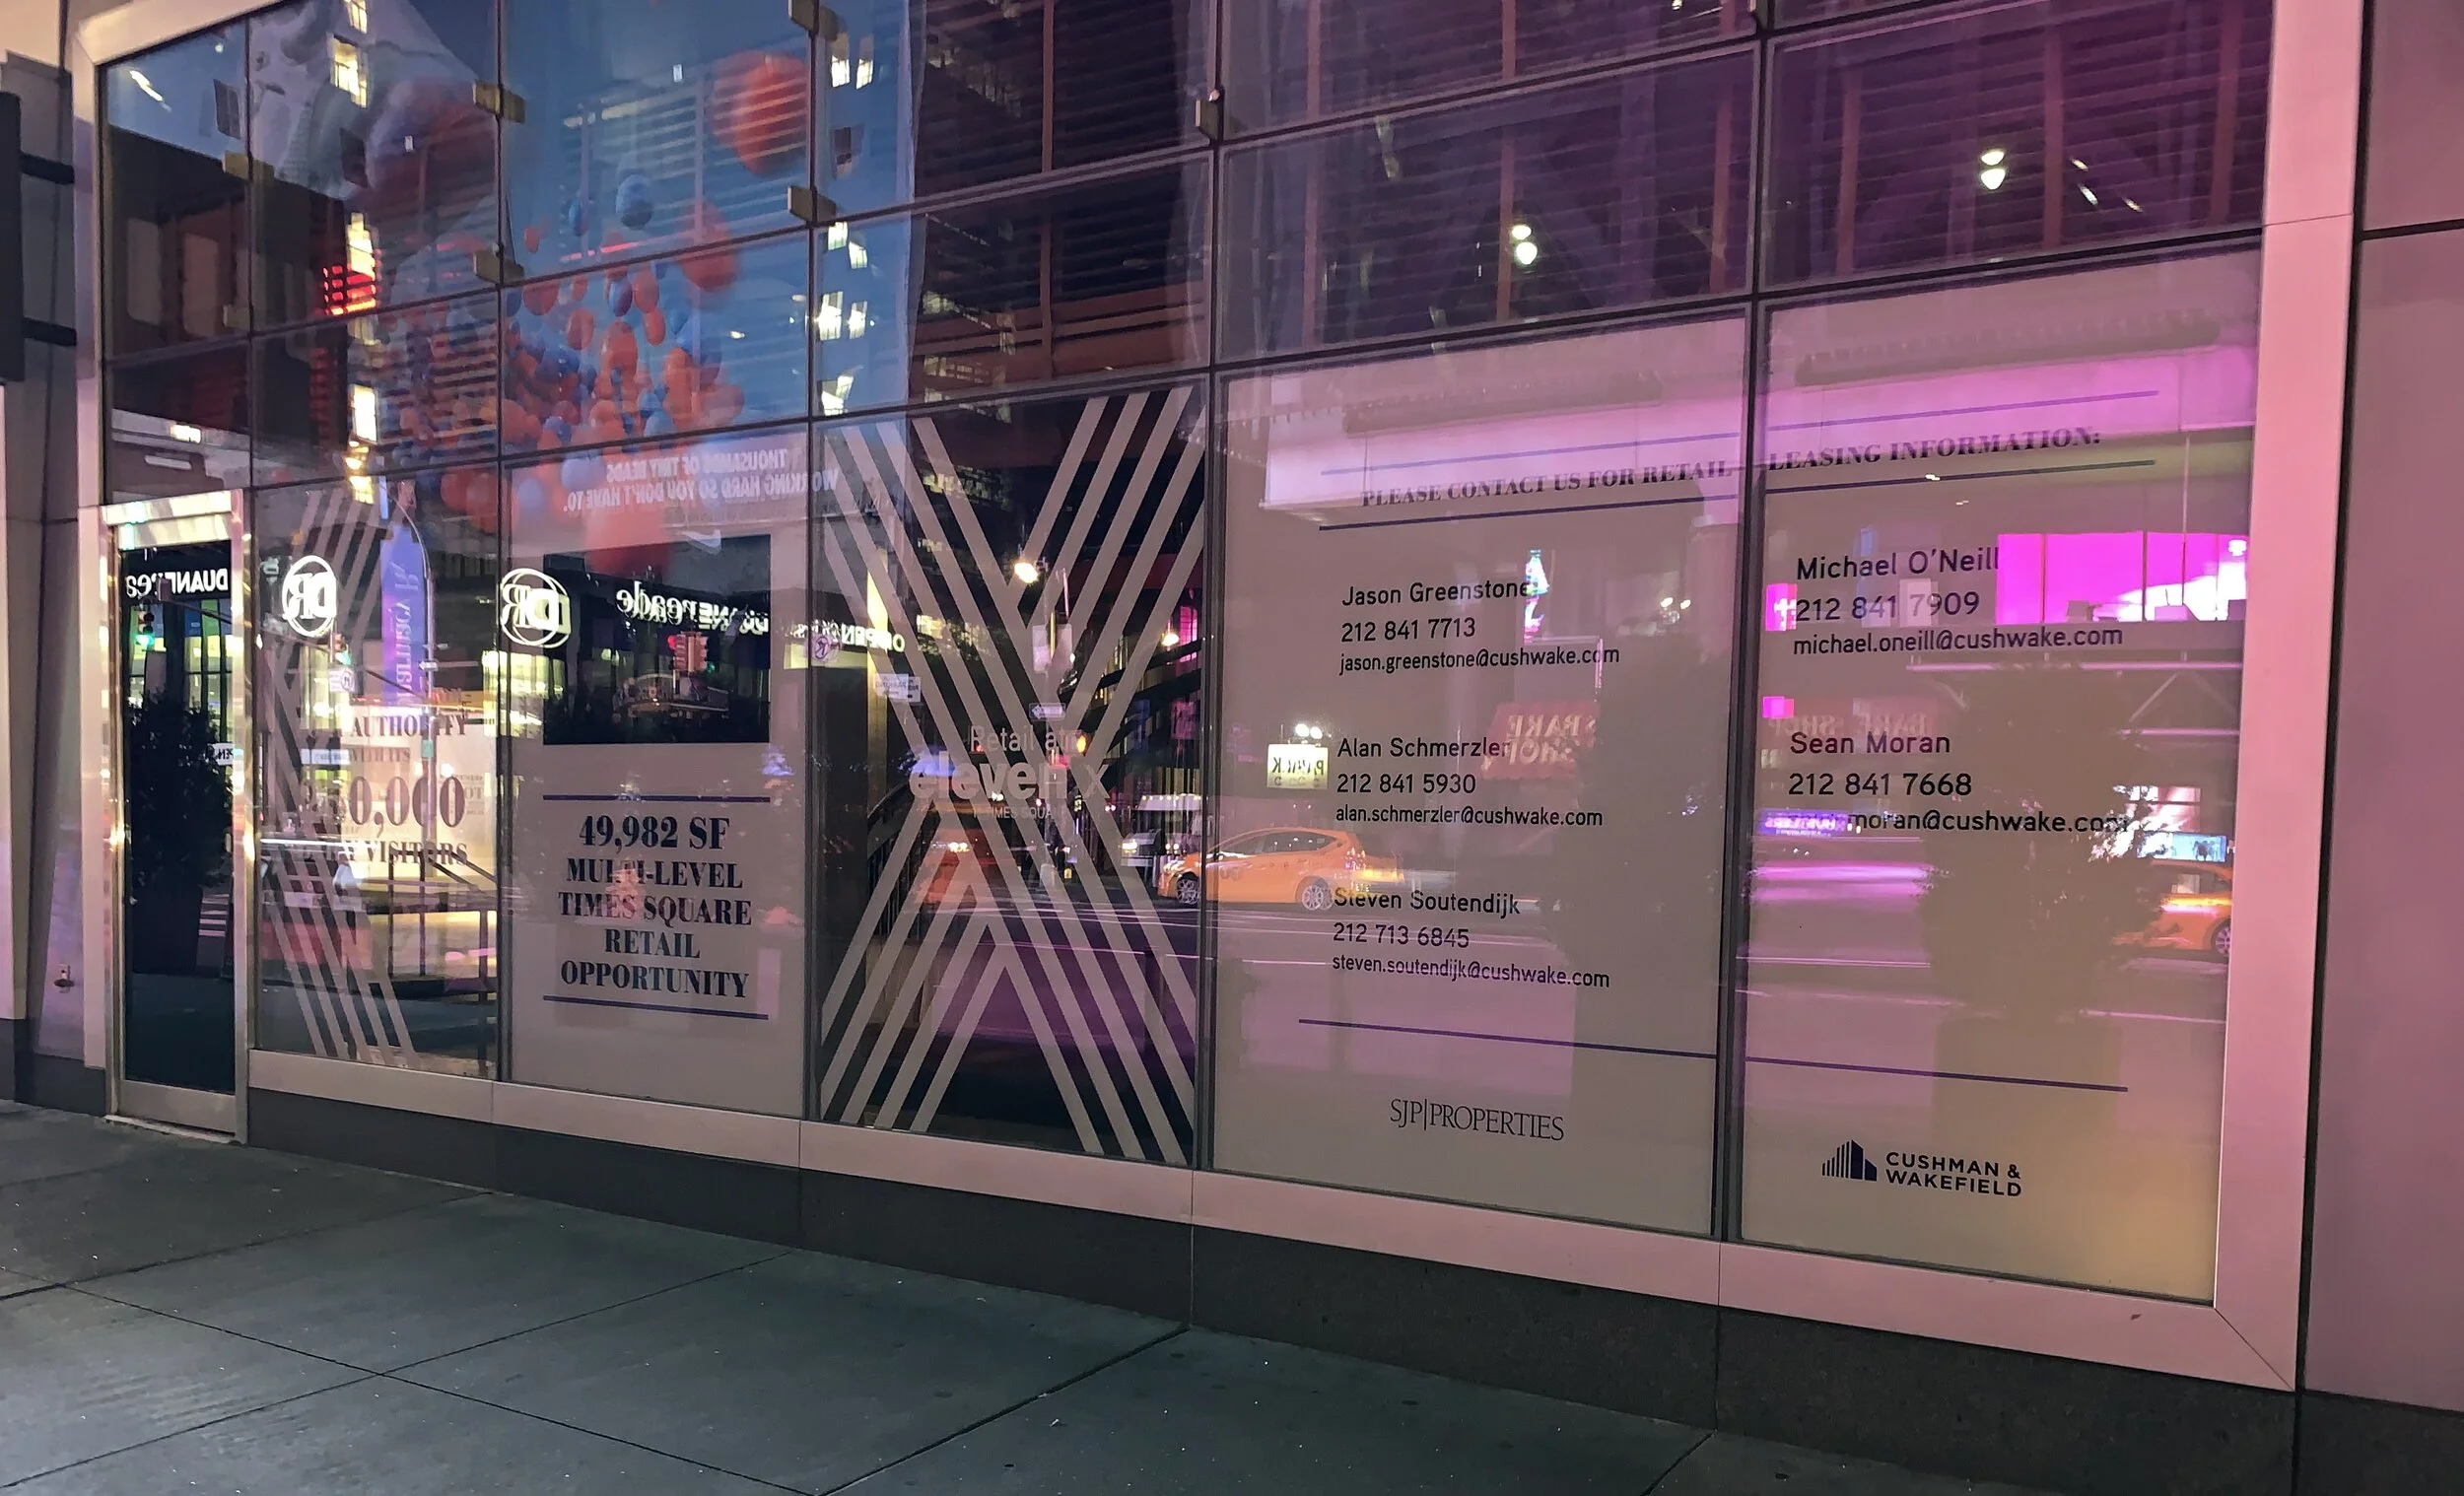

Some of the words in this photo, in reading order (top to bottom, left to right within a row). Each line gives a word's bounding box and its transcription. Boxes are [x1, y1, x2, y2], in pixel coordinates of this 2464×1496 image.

[1362, 486, 1442, 507] PLEASE
[1447, 476, 1544, 500] CONTACT
[1553, 472, 1581, 491] US
[1588, 468, 1636, 488] FOR
[1642, 460, 1734, 483] RETAIL
[1768, 443, 1881, 470] LEASING
[1889, 426, 2101, 461] INFORMATION:
[1796, 553, 1897, 579] Michael
[1909, 547, 2000, 574] O'Neill
[1341, 586, 1402, 607] Jason
[1409, 580, 1532, 603] Greenstone
[1795, 599, 1841, 622] 212
[1852, 596, 1896, 619] 841
[1909, 591, 1981, 616] 7909
[1341, 622, 1376, 643] 212
[1384, 620, 1419, 640] 841
[1428, 617, 1476, 639] 7713
[1794, 629, 2123, 654] michael.oneill@cushwake.com
[1339, 646, 1620, 676] jason.greenstone@cushwake.com
[1336, 737, 1382, 758] Alan
[1390, 737, 1511, 758] Schmerzler
[1790, 731, 1855, 754] Sean
[1866, 731, 1951, 754] Moran
[1336, 774, 1372, 793] 212
[1380, 774, 1414, 793] 841
[1423, 774, 1476, 793] 5930
[1788, 773, 1834, 795] 212
[1845, 773, 1890, 795] 841
[1902, 773, 1972, 795] 7668
[1335, 804, 1603, 826] alan.schmerzler@cushwake.com
[579, 814, 679, 854] 49,982
[689, 816, 731, 850] SF
[558, 891, 637, 918] TIMES
[643, 895, 753, 928] SQUARE
[1334, 887, 1403, 909] Steven
[1409, 890, 1521, 918] Soutendijk
[604, 928, 701, 959] RETAIL
[1333, 922, 1368, 942] 212
[1375, 924, 1409, 944] 713
[1417, 926, 1470, 948] 6845
[560, 960, 749, 998] OPPORTUNITY
[1332, 954, 1610, 987] steven.soutendijk@cushwake.com
[1885, 1151, 1999, 1177] CUSHMAN
[2007, 1163, 2021, 1180] &
[1884, 1169, 2022, 1197] WAKEFIELD
